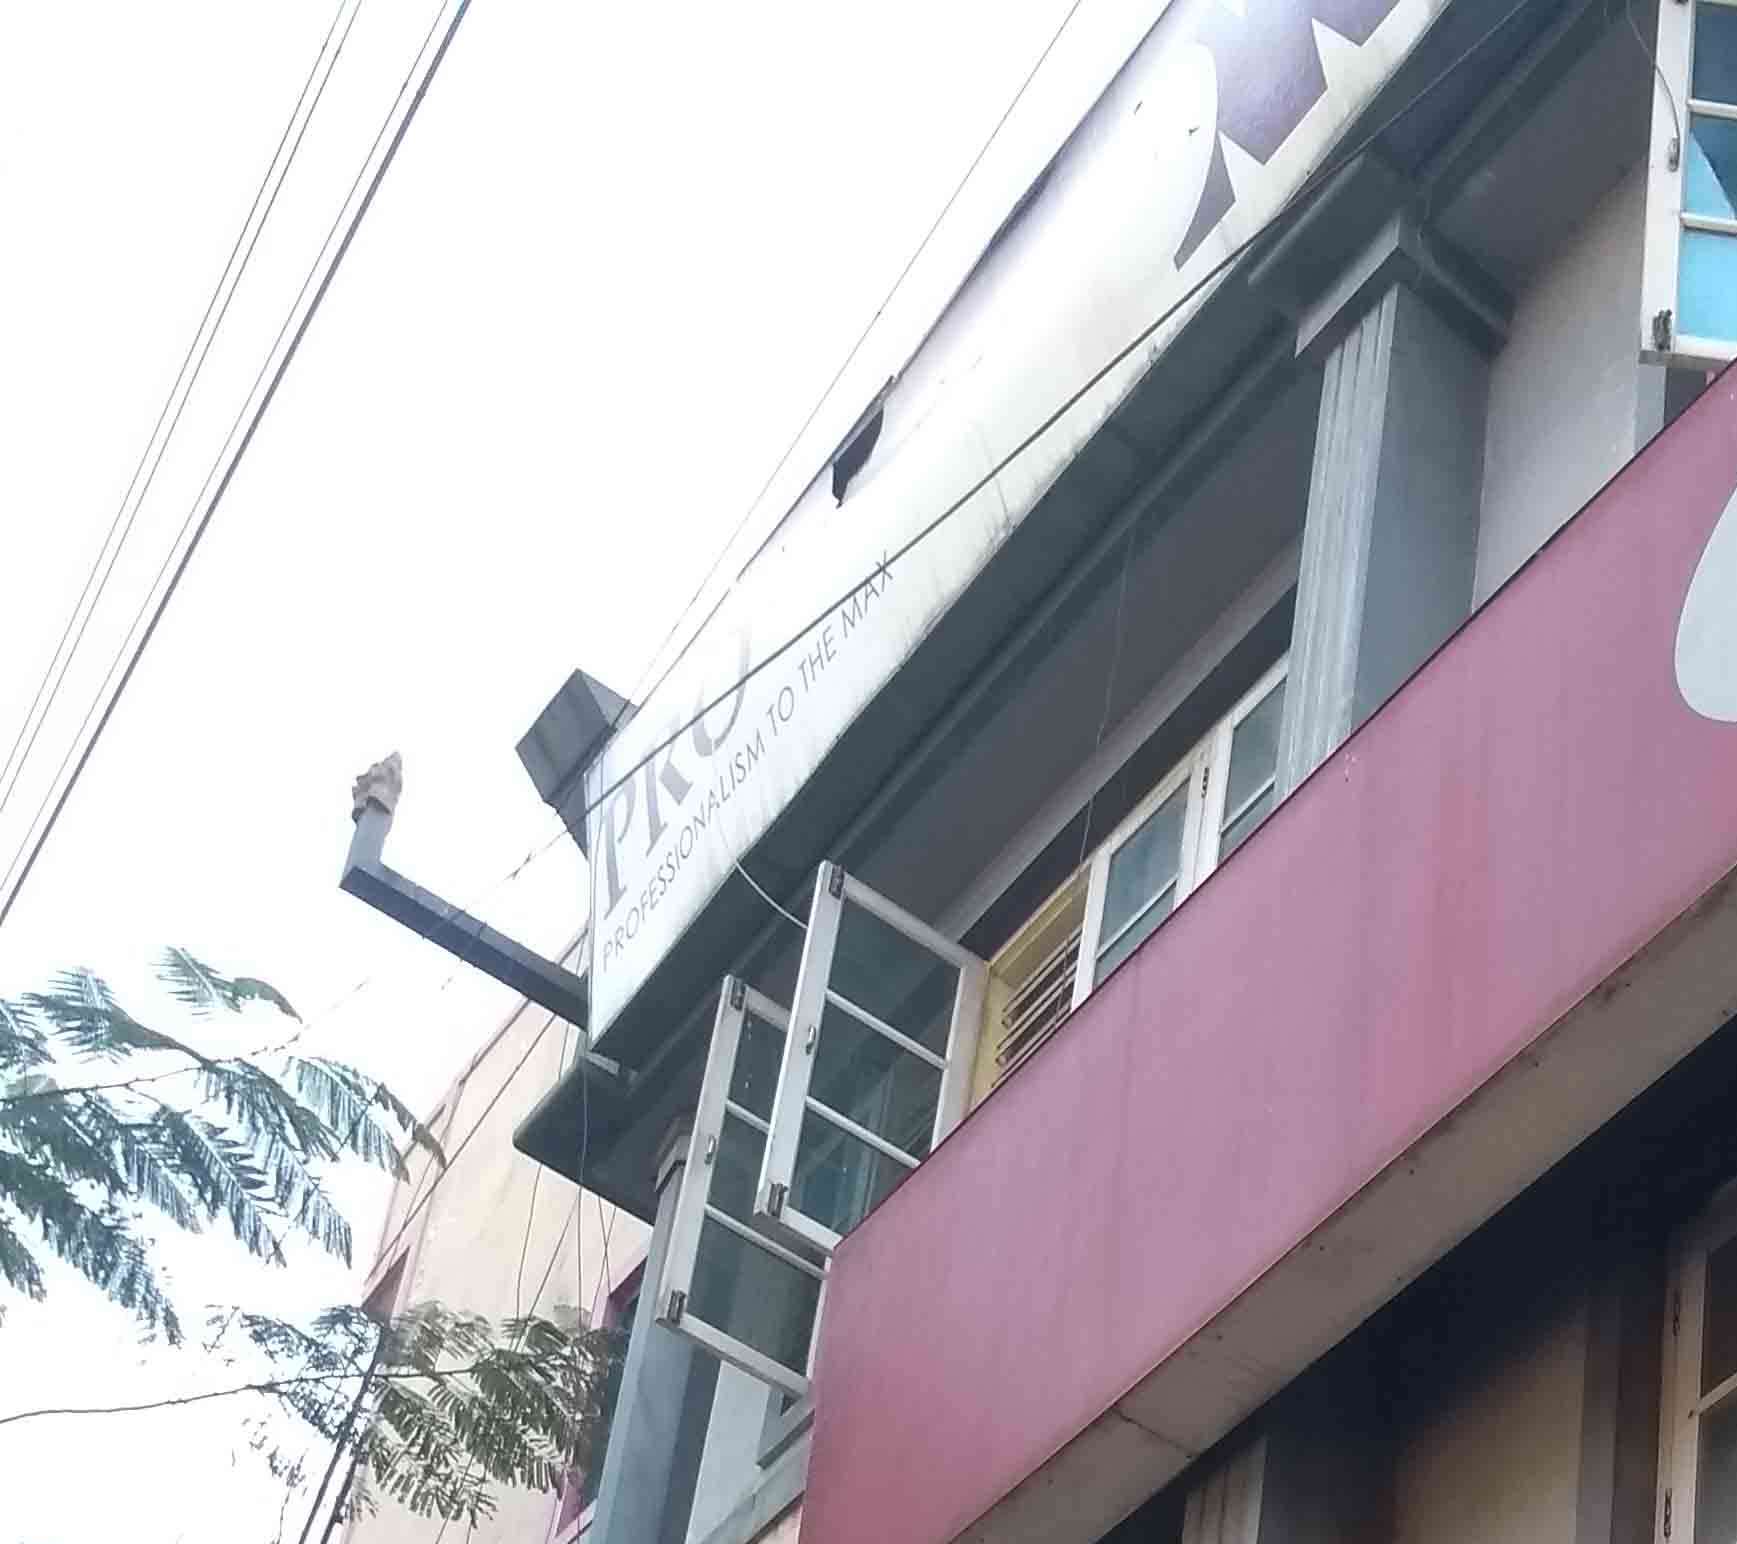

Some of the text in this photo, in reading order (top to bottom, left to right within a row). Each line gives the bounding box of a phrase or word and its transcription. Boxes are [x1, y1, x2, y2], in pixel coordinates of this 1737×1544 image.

[603, 550, 893, 972] PROFESSIONALISM TO THE MAX
